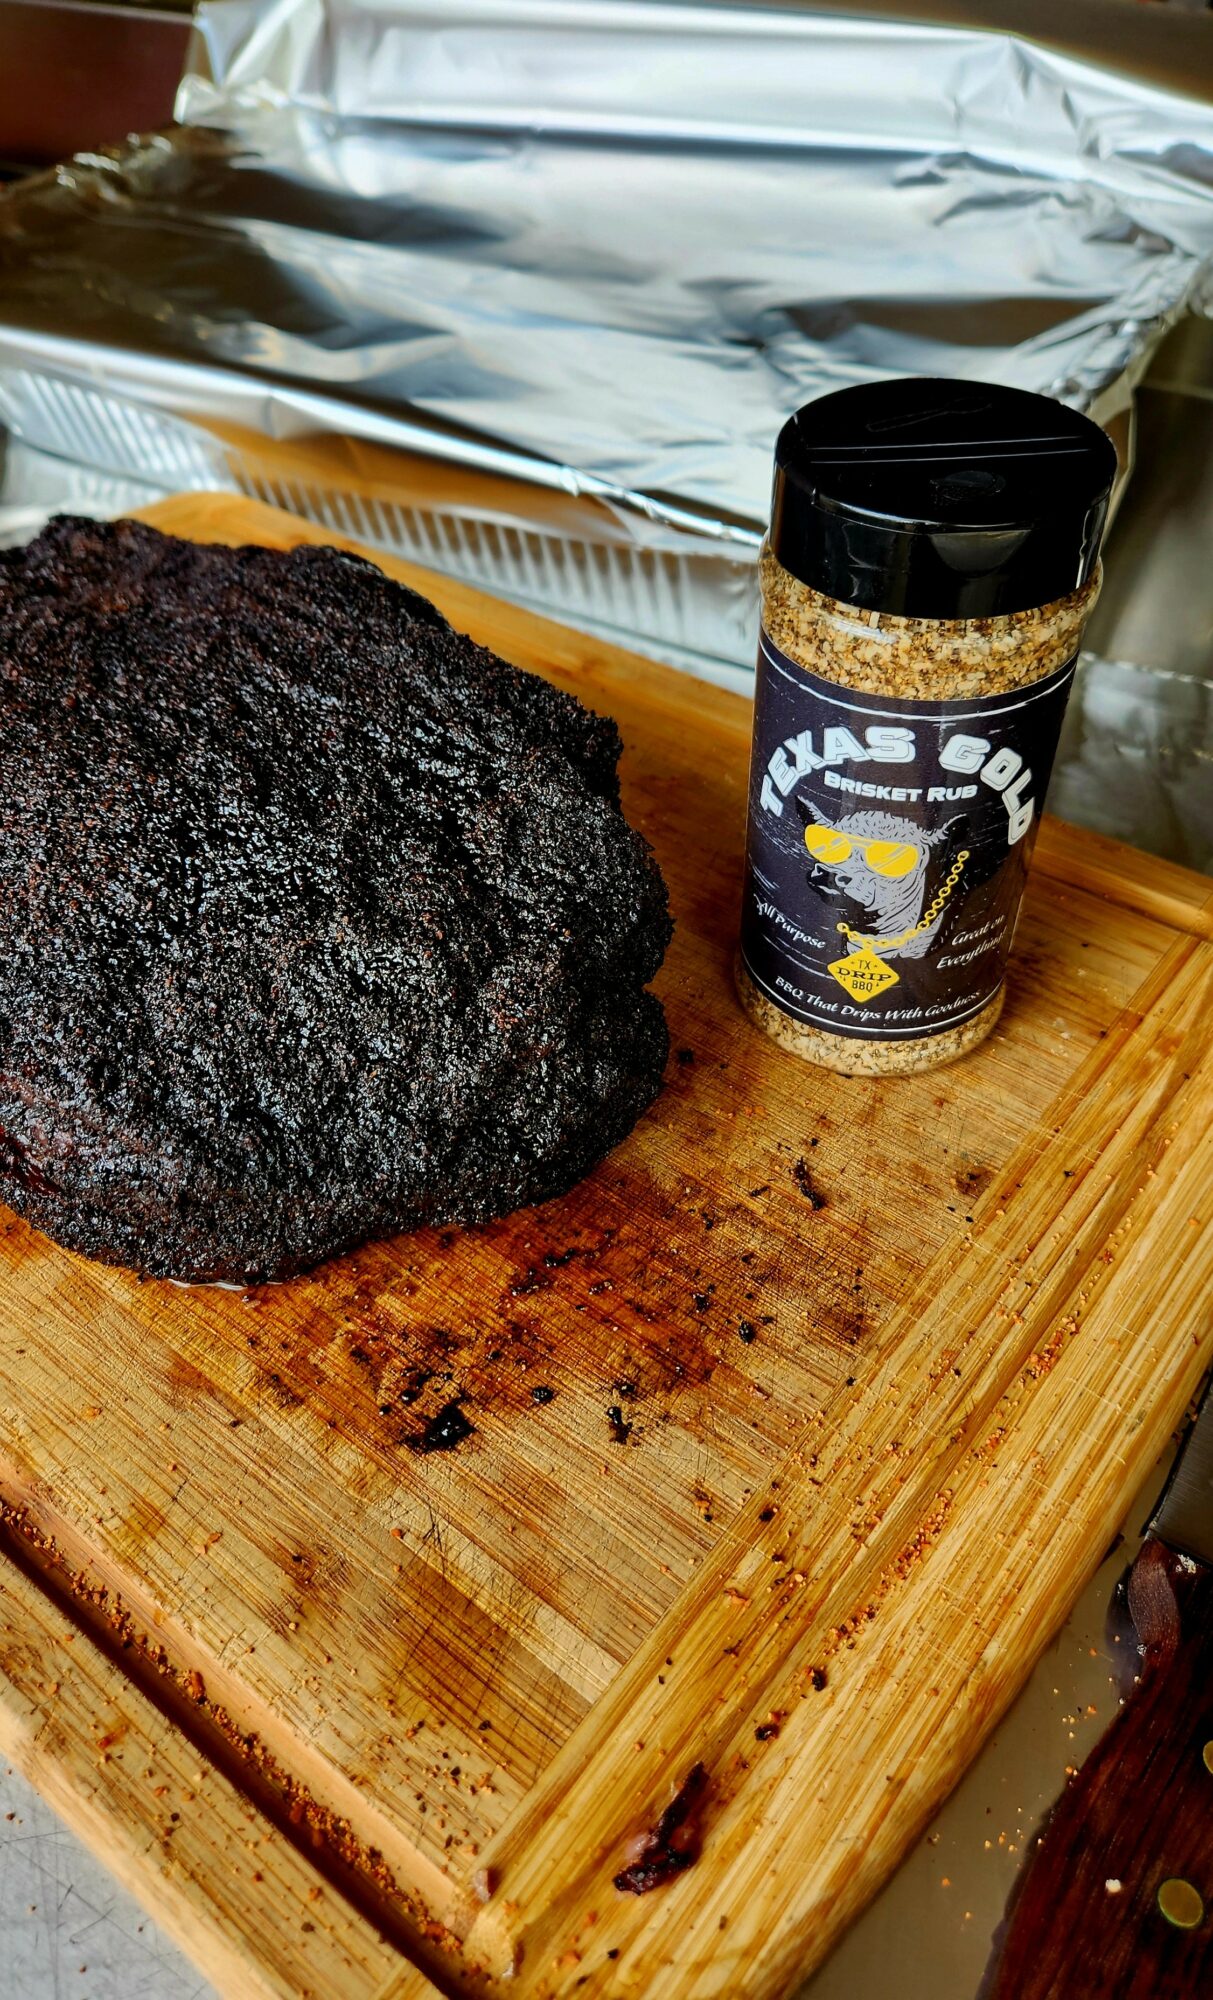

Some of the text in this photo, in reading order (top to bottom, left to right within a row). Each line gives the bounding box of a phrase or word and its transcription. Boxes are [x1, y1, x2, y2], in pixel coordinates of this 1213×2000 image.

[760, 726, 1036, 845] TEXAS GOLD
[824, 770, 978, 802] BRISKET RUB
[756, 902, 826, 949] All Purpose
[951, 921, 990, 946] Great
[836, 966, 892, 982] DRIP
[857, 959, 871, 970] TX
[775, 976, 980, 1022] BBQ That Drips With Goodness
[852, 979, 873, 993] BBQ
